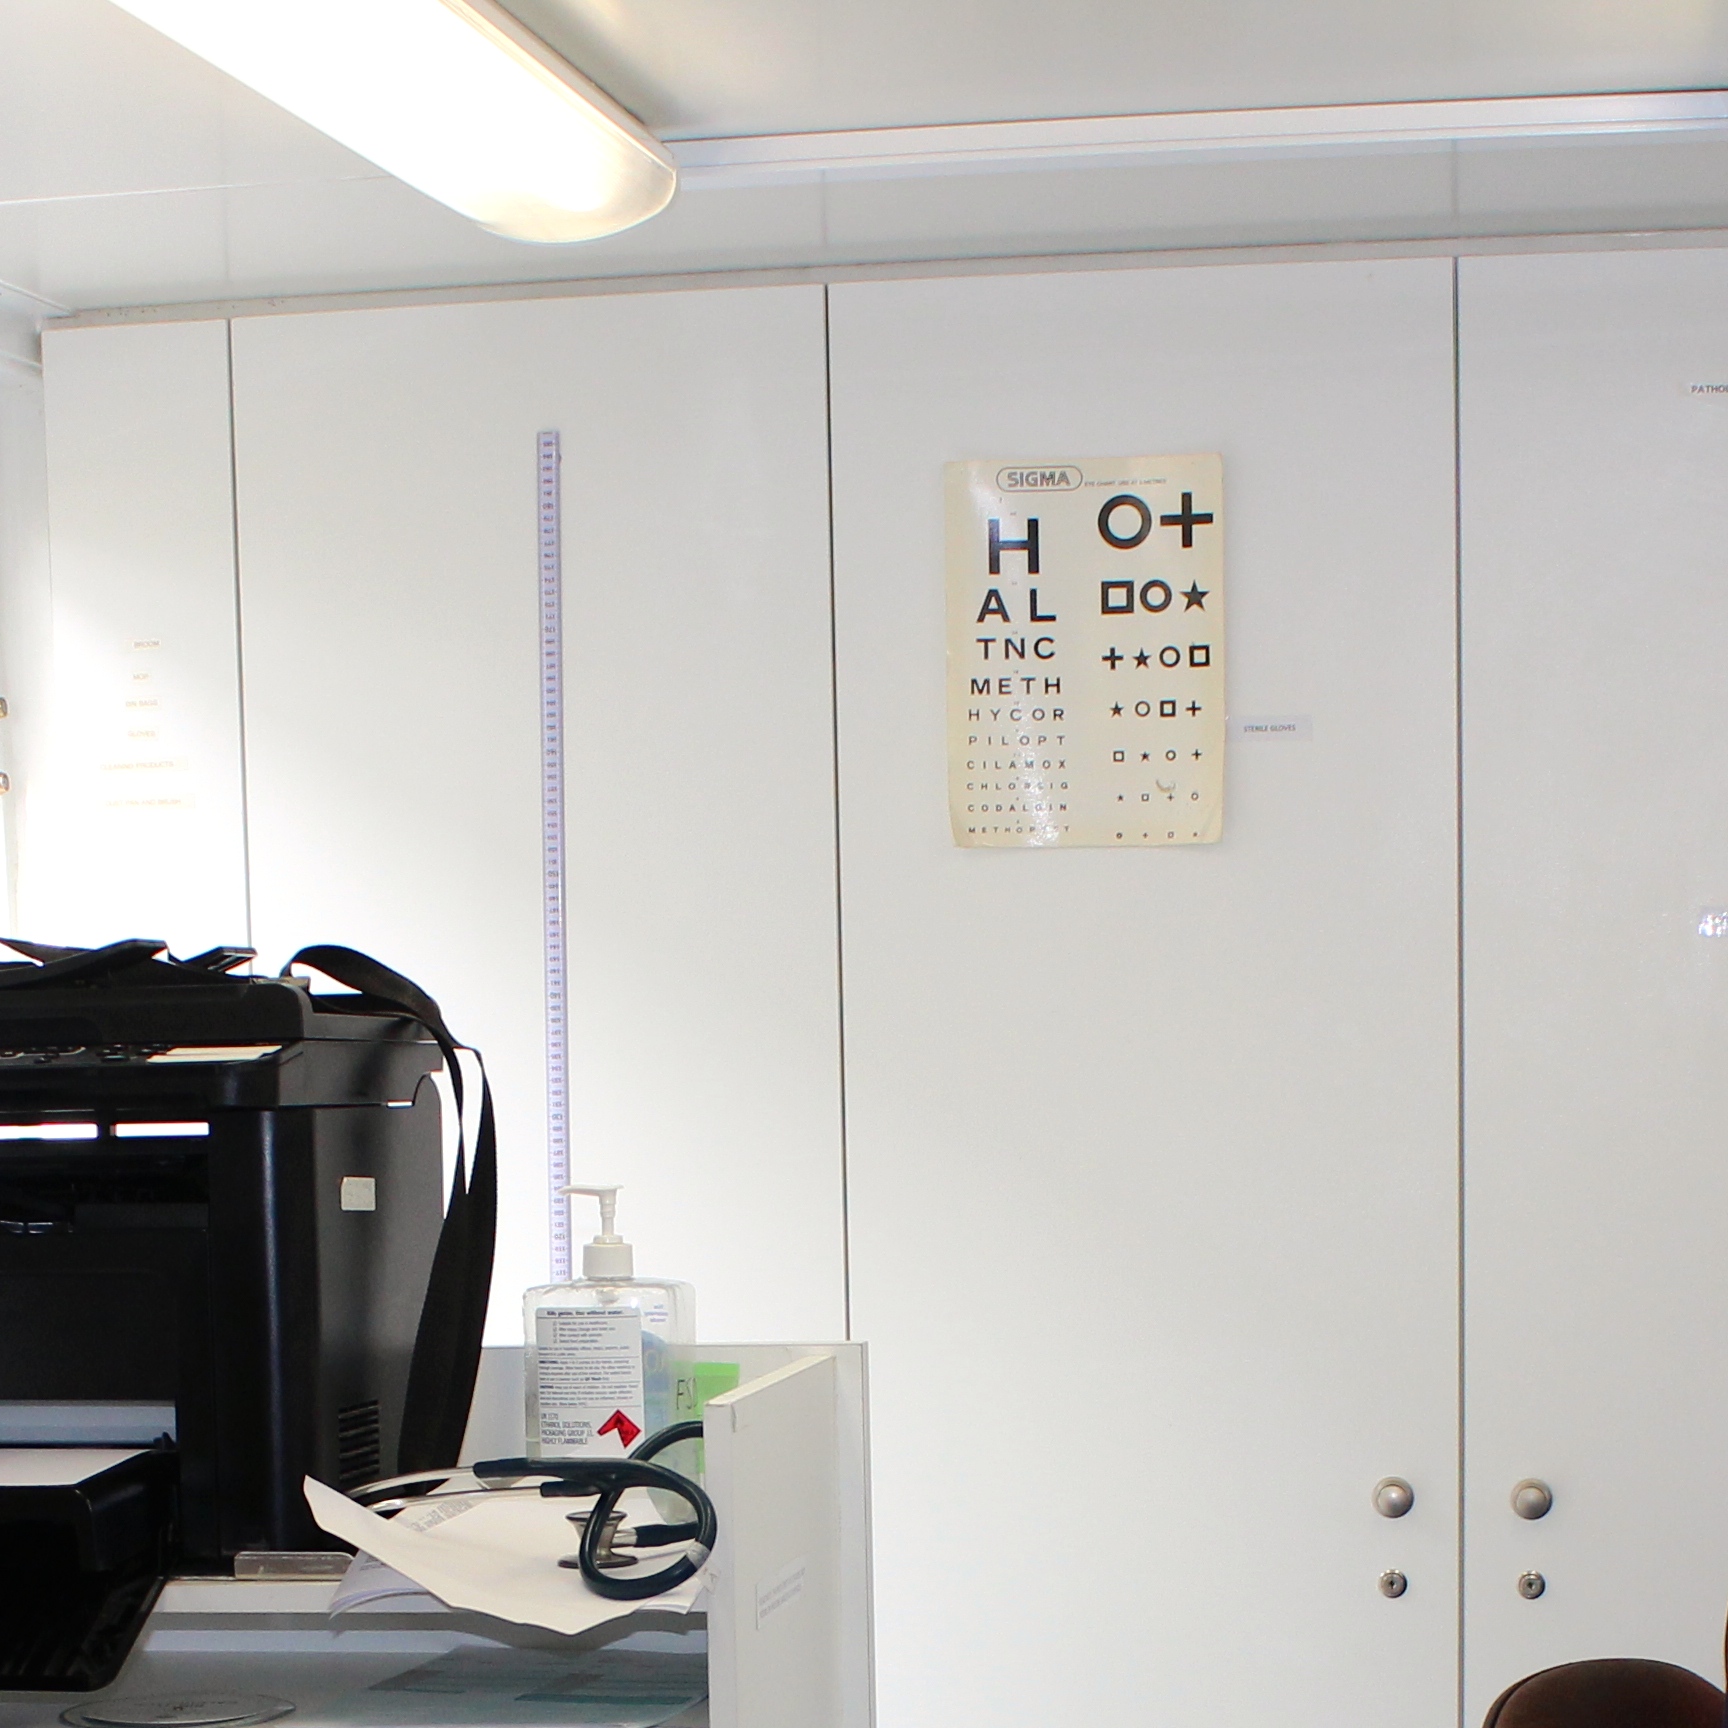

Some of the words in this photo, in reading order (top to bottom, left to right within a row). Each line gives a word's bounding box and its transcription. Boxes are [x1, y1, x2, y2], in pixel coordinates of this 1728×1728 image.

[1007, 471, 1070, 487] SIGMA
[989, 517, 1039, 574] H
[977, 588, 1057, 623] AL
[134, 640, 160, 648] BROOM
[976, 636, 1056, 661] TNC
[970, 677, 1060, 695] METH
[969, 709, 1064, 721] HYCOR
[969, 736, 1065, 745] PILOPT
[967, 761, 1066, 770] CILAMOX
[969, 826, 1069, 834] METHOPT
